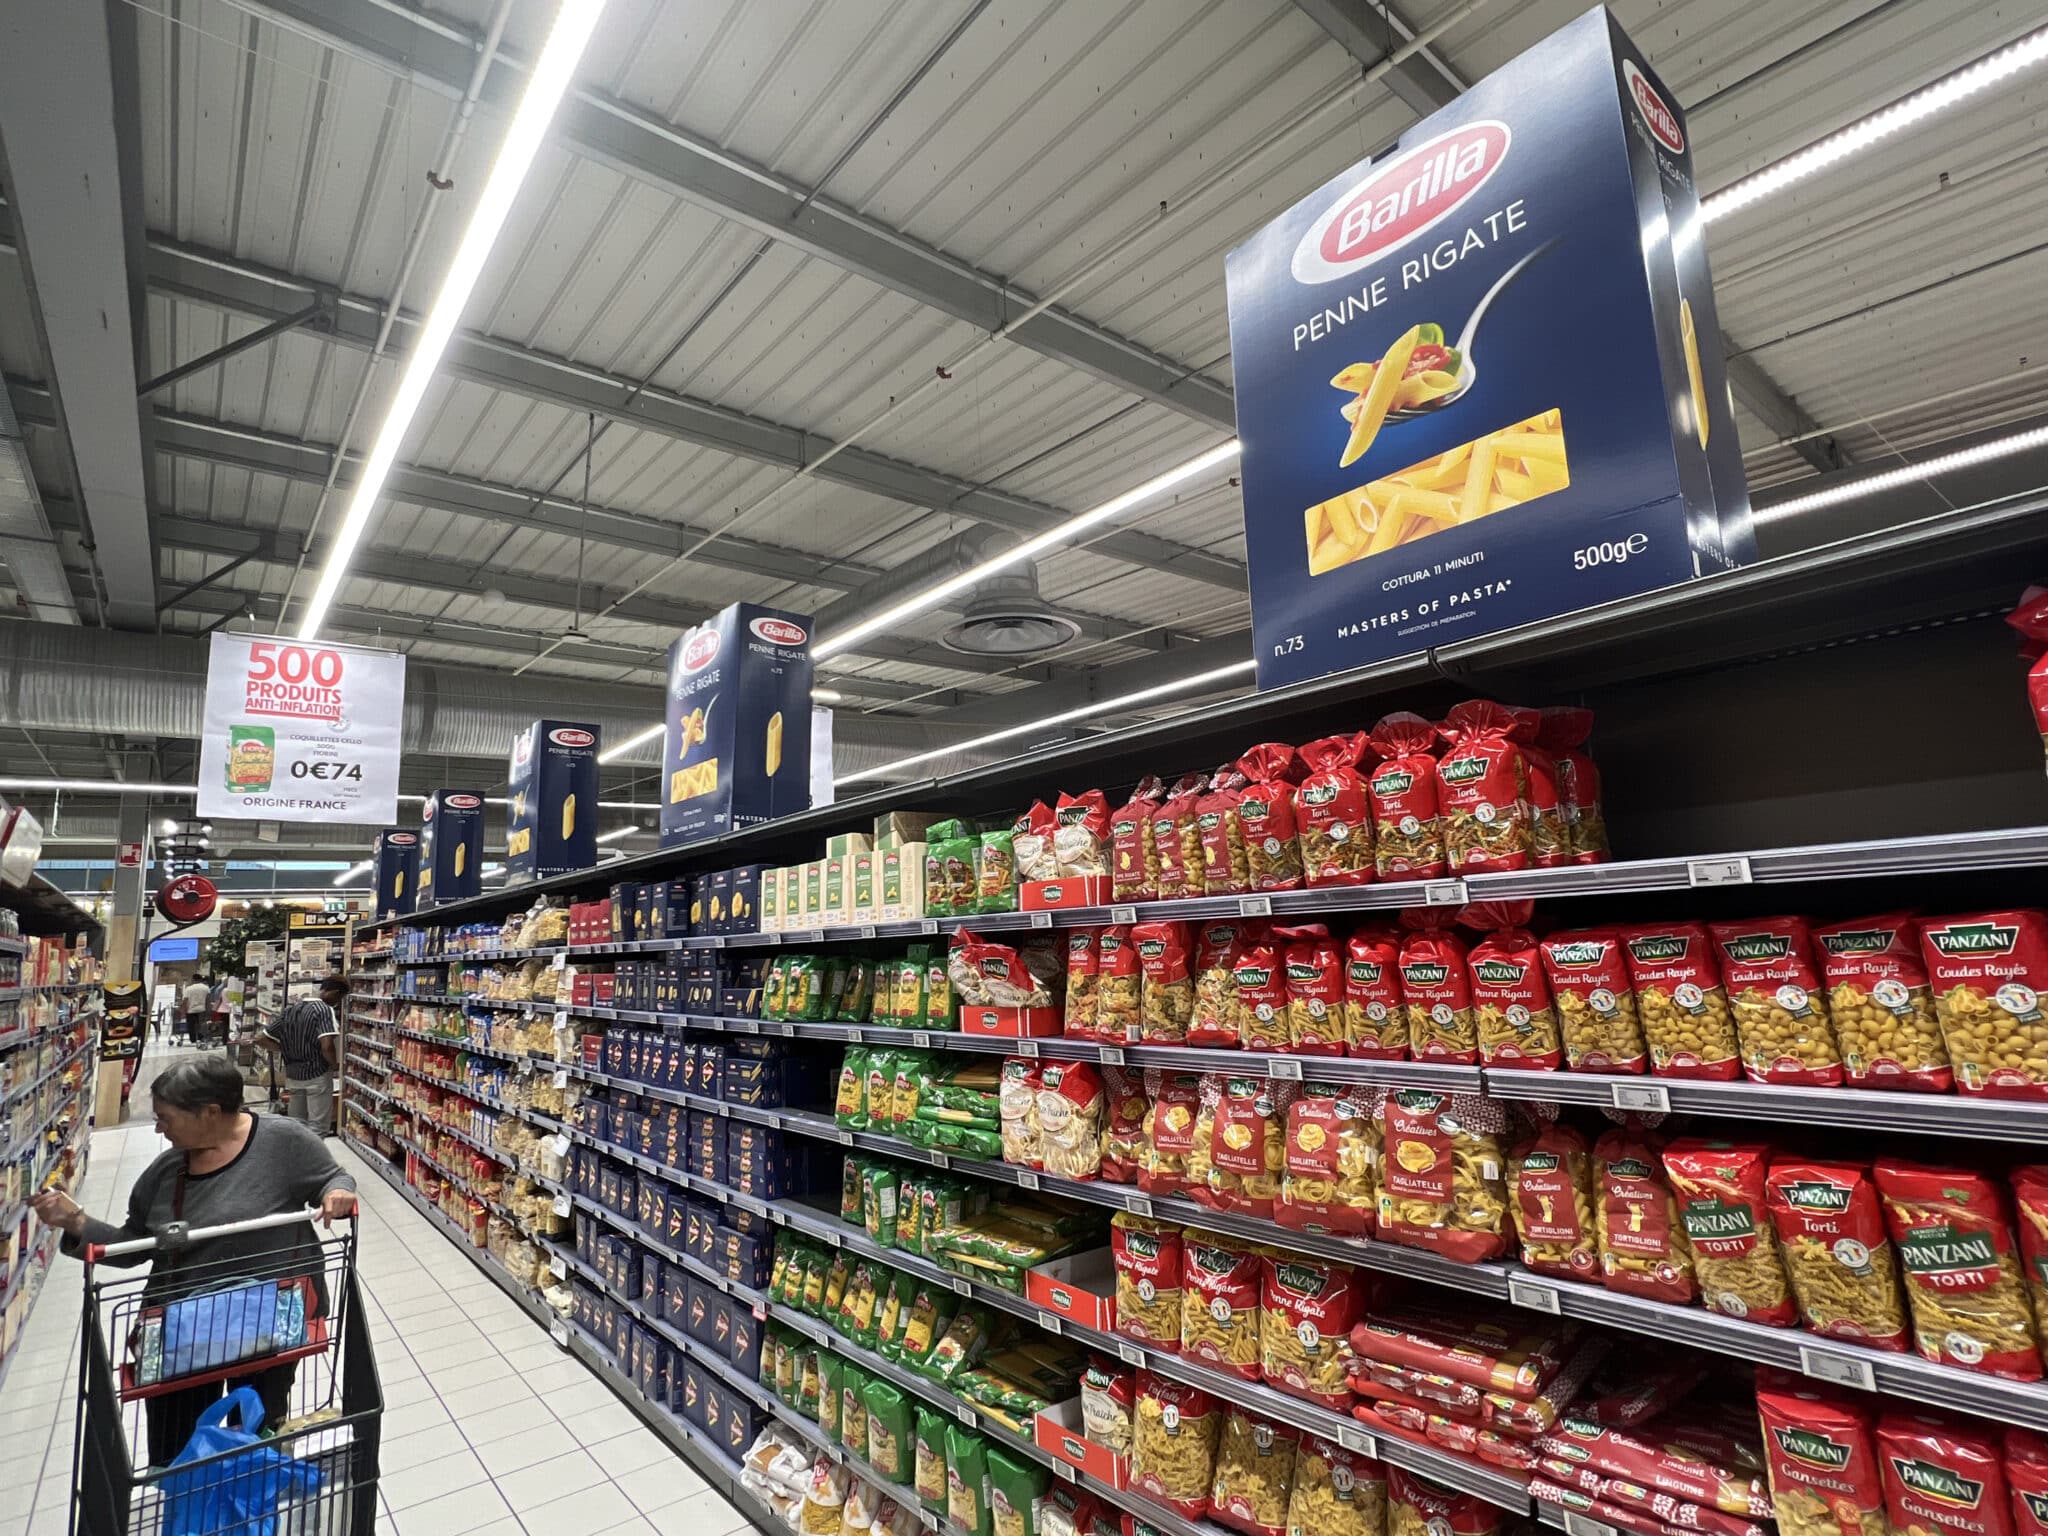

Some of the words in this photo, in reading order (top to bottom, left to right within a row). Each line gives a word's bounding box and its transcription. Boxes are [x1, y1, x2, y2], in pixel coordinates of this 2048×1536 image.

[1636, 80, 1679, 146] Barilla
[1336, 136, 1489, 256] Barilla
[1293, 277, 1389, 352] PENNE
[1401, 199, 1528, 290] RIGATE
[1381, 568, 1431, 592] COTTURA
[1445, 550, 1486, 574] MINUTI
[1337, 608, 1410, 639] MASTERS
[1418, 599, 1441, 617] OF
[763, 623, 803, 641] Barilla
[749, 642, 776, 656] PENNE
[778, 649, 807, 662] RIGATE
[1273, 634, 1305, 658] n.73
[247, 641, 344, 688] 500
[246, 680, 343, 705] PRODUITS
[290, 760, 363, 782] 0€74
[1446, 761, 1484, 779] PANZANI
[1375, 776, 1409, 793] PANZANI
[1455, 787, 1478, 799] Torti
[243, 796, 296, 809] ORIGINE
[299, 798, 347, 811] FRANCE
[1383, 799, 1402, 811] Torti
[1730, 941, 1785, 958] PANZANI
[1827, 935, 1887, 949] PANZANI
[1939, 933, 2010, 949] PANZANI
[1554, 949, 1601, 963] PANZANI
[1635, 942, 1684, 958] PANZANI
[1405, 968, 1443, 980] PANZANI
[1478, 967, 1520, 980] PANZANI
[1634, 970, 1665, 981] Coudes
[1667, 967, 1697, 982] Rayés
[1732, 970, 1765, 982] Coudes
[1826, 964, 1861, 977] Coudes
[1863, 960, 1900, 977] Rayés
[1936, 964, 1982, 979] Coudes
[1985, 962, 2028, 980] Rayés
[1553, 973, 1581, 984] Coudes
[1582, 972, 1610, 985] Rayés
[1251, 990, 1276, 1001] Rigate
[1304, 985, 1328, 995] Rigate
[1362, 987, 1388, 998] Rigate
[1404, 989, 1422, 998] Penne
[1424, 988, 1455, 1001] Rigate
[1475, 989, 1499, 998] Penne
[1501, 988, 1533, 1002] Rigate
[1216, 1152, 1257, 1166] TAGLIATELLE
[1289, 1156, 1329, 1169] TAGLIATELLE
[1392, 1175, 1444, 1191] TAGLIATELLE
[1788, 1187, 1844, 1206] PANZANI
[1686, 1211, 1750, 1235] PANZANI
[1800, 1217, 1840, 1235] Torti
[1613, 1233, 1662, 1247] TORTIGLIONI
[1704, 1239, 1746, 1253] TORTI
[1901, 1239, 1991, 1266] PANZANI
[1279, 1267, 1322, 1292] PANZANI
[1929, 1271, 1986, 1288] TORTI
[1294, 1298, 1326, 1319] Rigate
[1781, 1432, 1844, 1463] PANZANI
[1661, 1458, 1705, 1478] LINGUINE
[1655, 1473, 1705, 1497] LINGUINE
[1780, 1461, 1856, 1495] Gansettes
[1903, 1466, 1974, 1500] PANZANI
[1901, 1496, 1985, 1534] Gansettes
